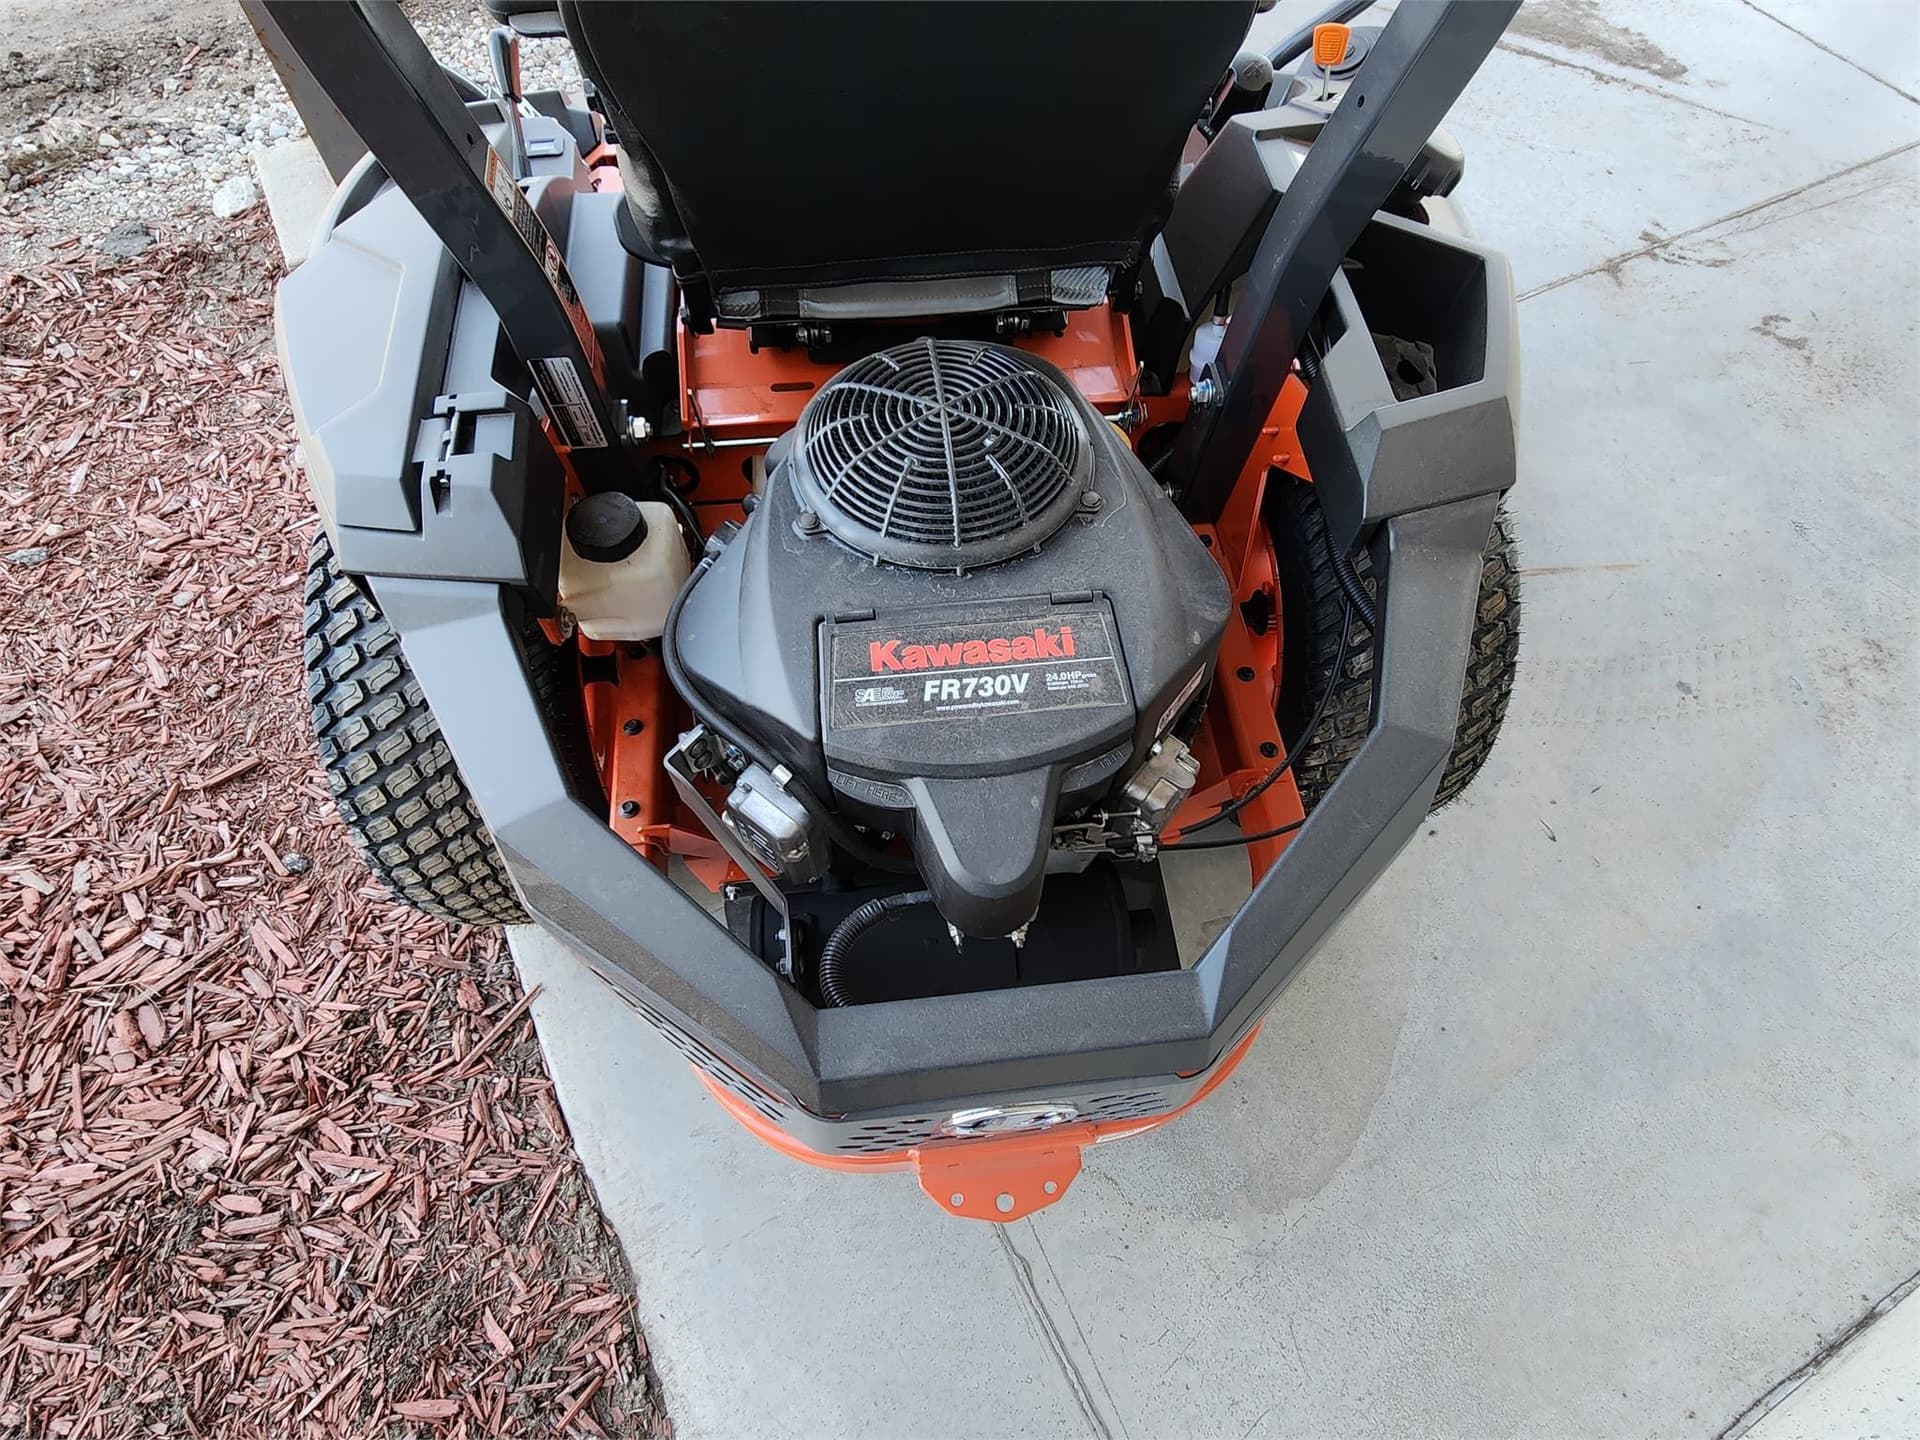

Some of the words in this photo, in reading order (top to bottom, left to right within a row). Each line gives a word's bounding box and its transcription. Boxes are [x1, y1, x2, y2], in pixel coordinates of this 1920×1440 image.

[869, 626, 1075, 672] Kawasaki
[923, 672, 1030, 702] FR730V
[833, 774, 863, 790] LIFT
[864, 783, 898, 803] HERE
